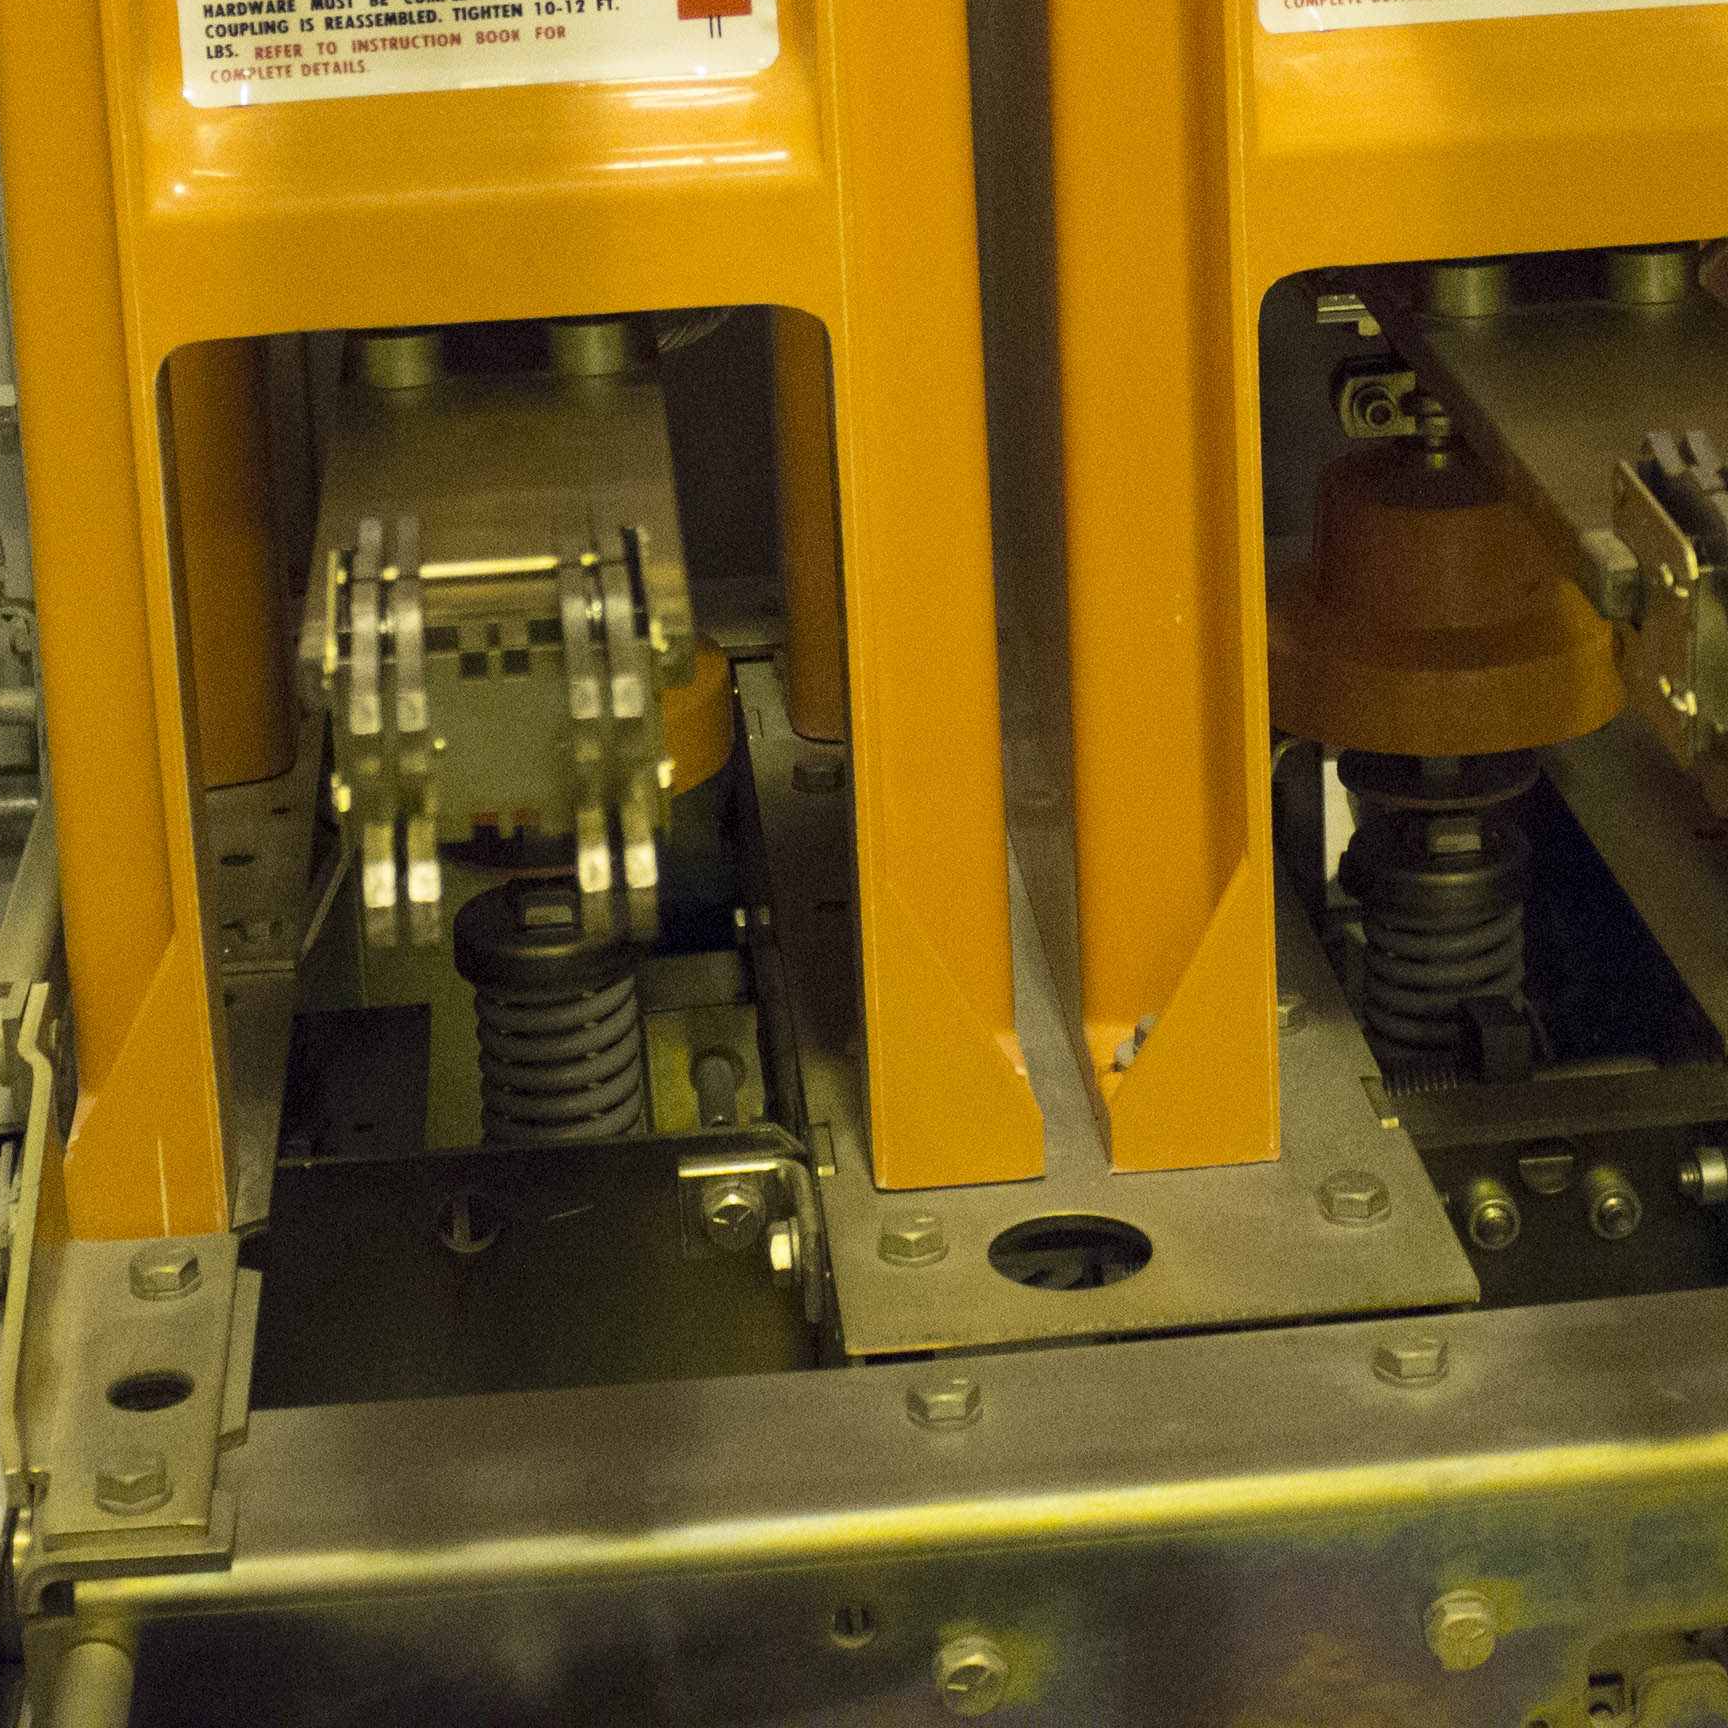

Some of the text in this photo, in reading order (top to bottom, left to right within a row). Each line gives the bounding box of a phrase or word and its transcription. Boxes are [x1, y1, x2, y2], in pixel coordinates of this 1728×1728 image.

[205, 19, 289, 39] COUPLING
[300, 18, 314, 33] IS
[325, 9, 443, 31] REASSEMBLED.
[452, 3, 523, 22] TIGHTEN
[535, 0, 584, 17] 10-12
[206, 25, 566, 60] LBS. REFER TO INSTRUCTION BOOK FOR
